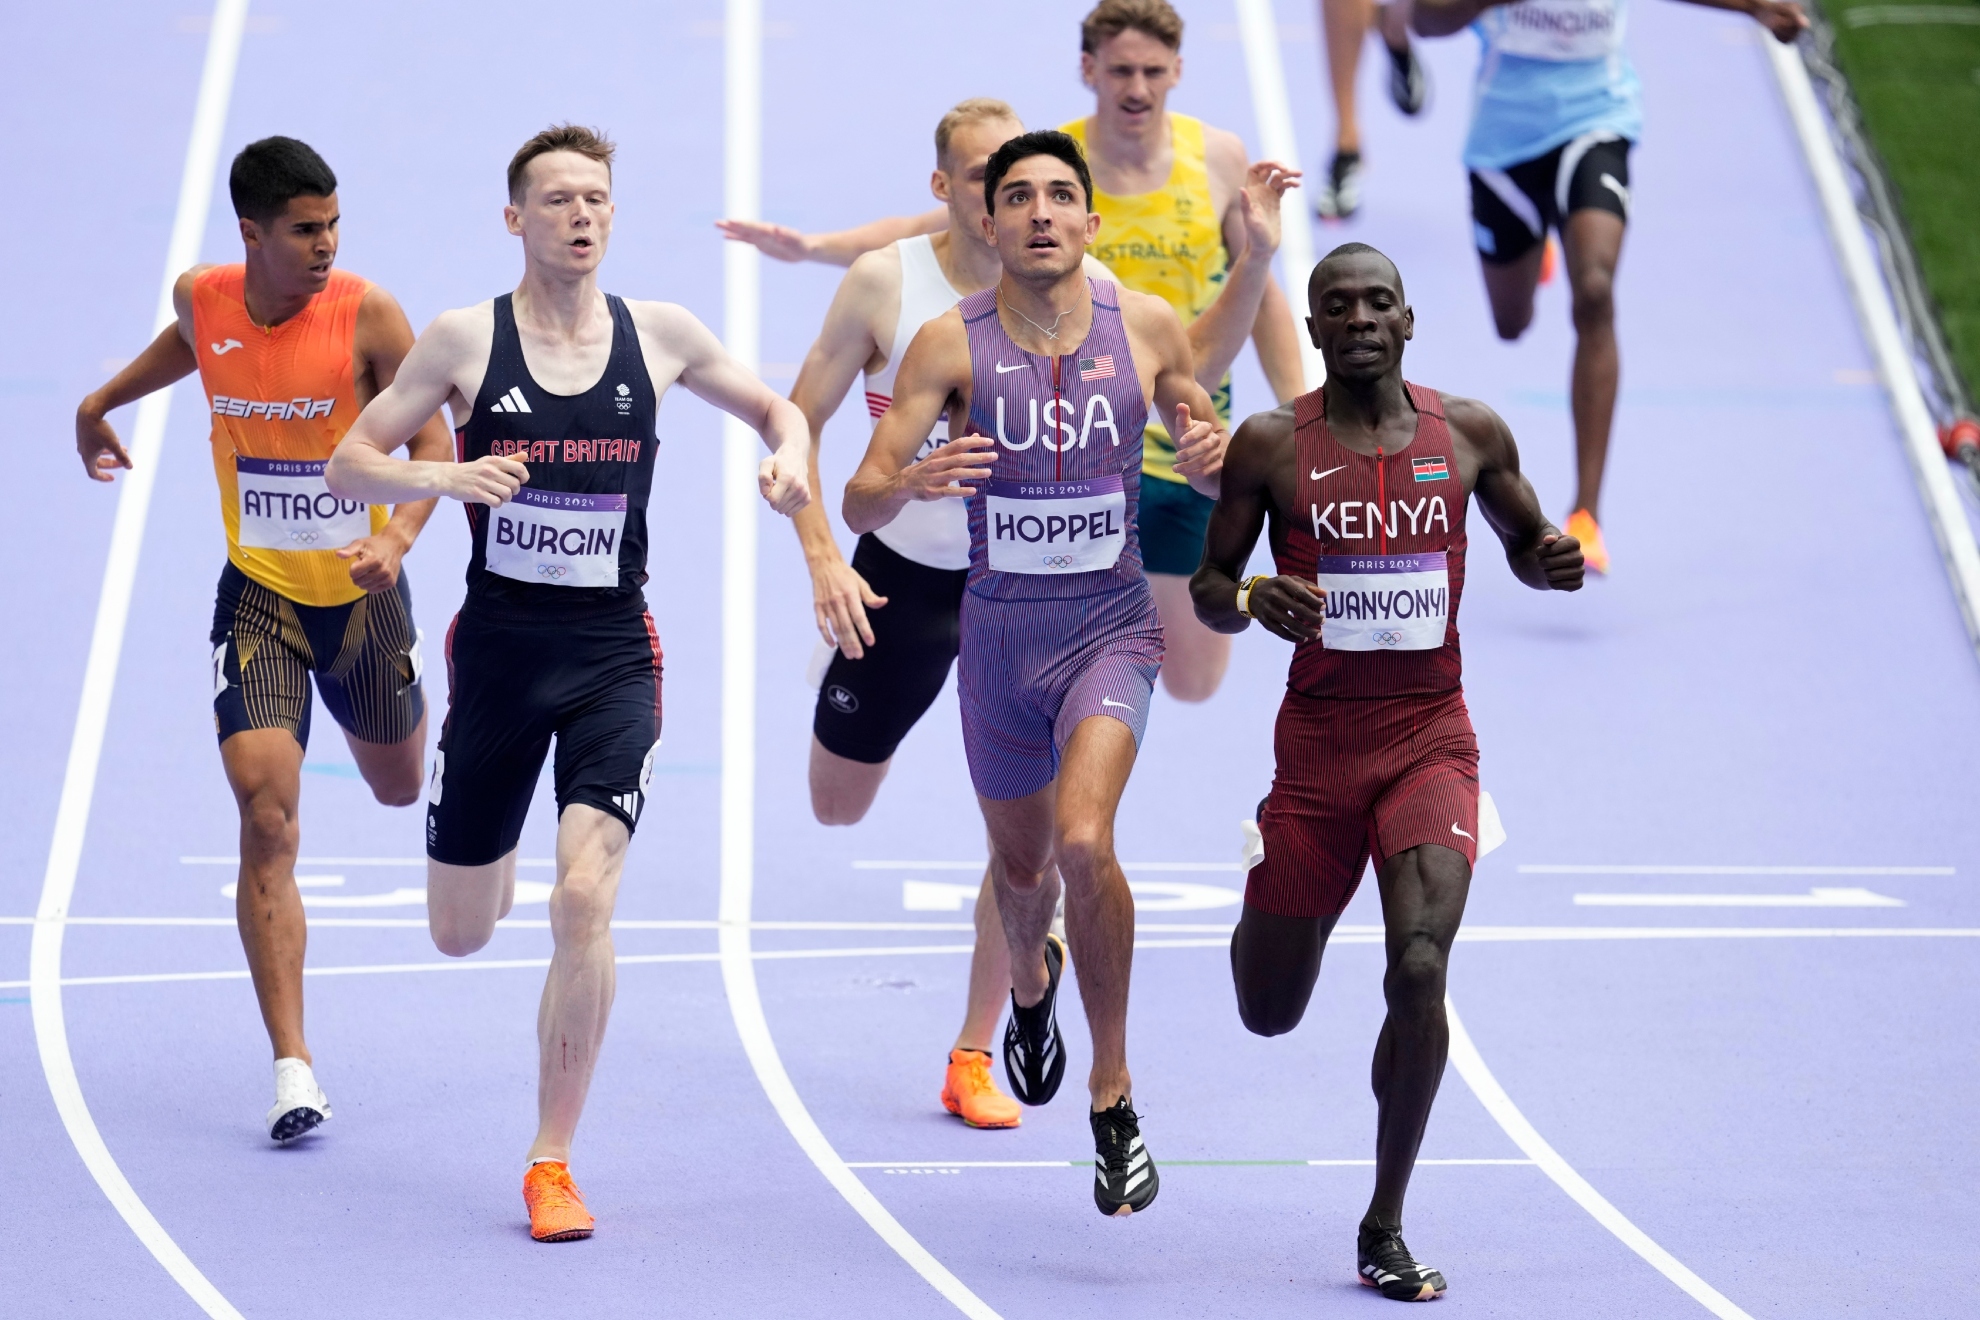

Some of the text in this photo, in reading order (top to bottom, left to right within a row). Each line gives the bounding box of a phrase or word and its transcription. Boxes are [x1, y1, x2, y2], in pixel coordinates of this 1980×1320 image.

[1085, 241, 1193, 261] USTRALIA
[211, 394, 336, 421] ESPAÑA
[996, 394, 1120, 452] USA
[490, 438, 641, 463] GREAT BRITAIN
[268, 462, 302, 473] PARIS
[526, 492, 596, 508] PARIS 2024
[1020, 484, 1091, 495] PARIS 2024
[995, 509, 1120, 543] HOPPEL
[1310, 495, 1449, 540] KENYA
[495, 516, 616, 556] BURGIN
[1350, 559, 1420, 570] PARIS 2024
[1323, 587, 1446, 621] WANYONYI
